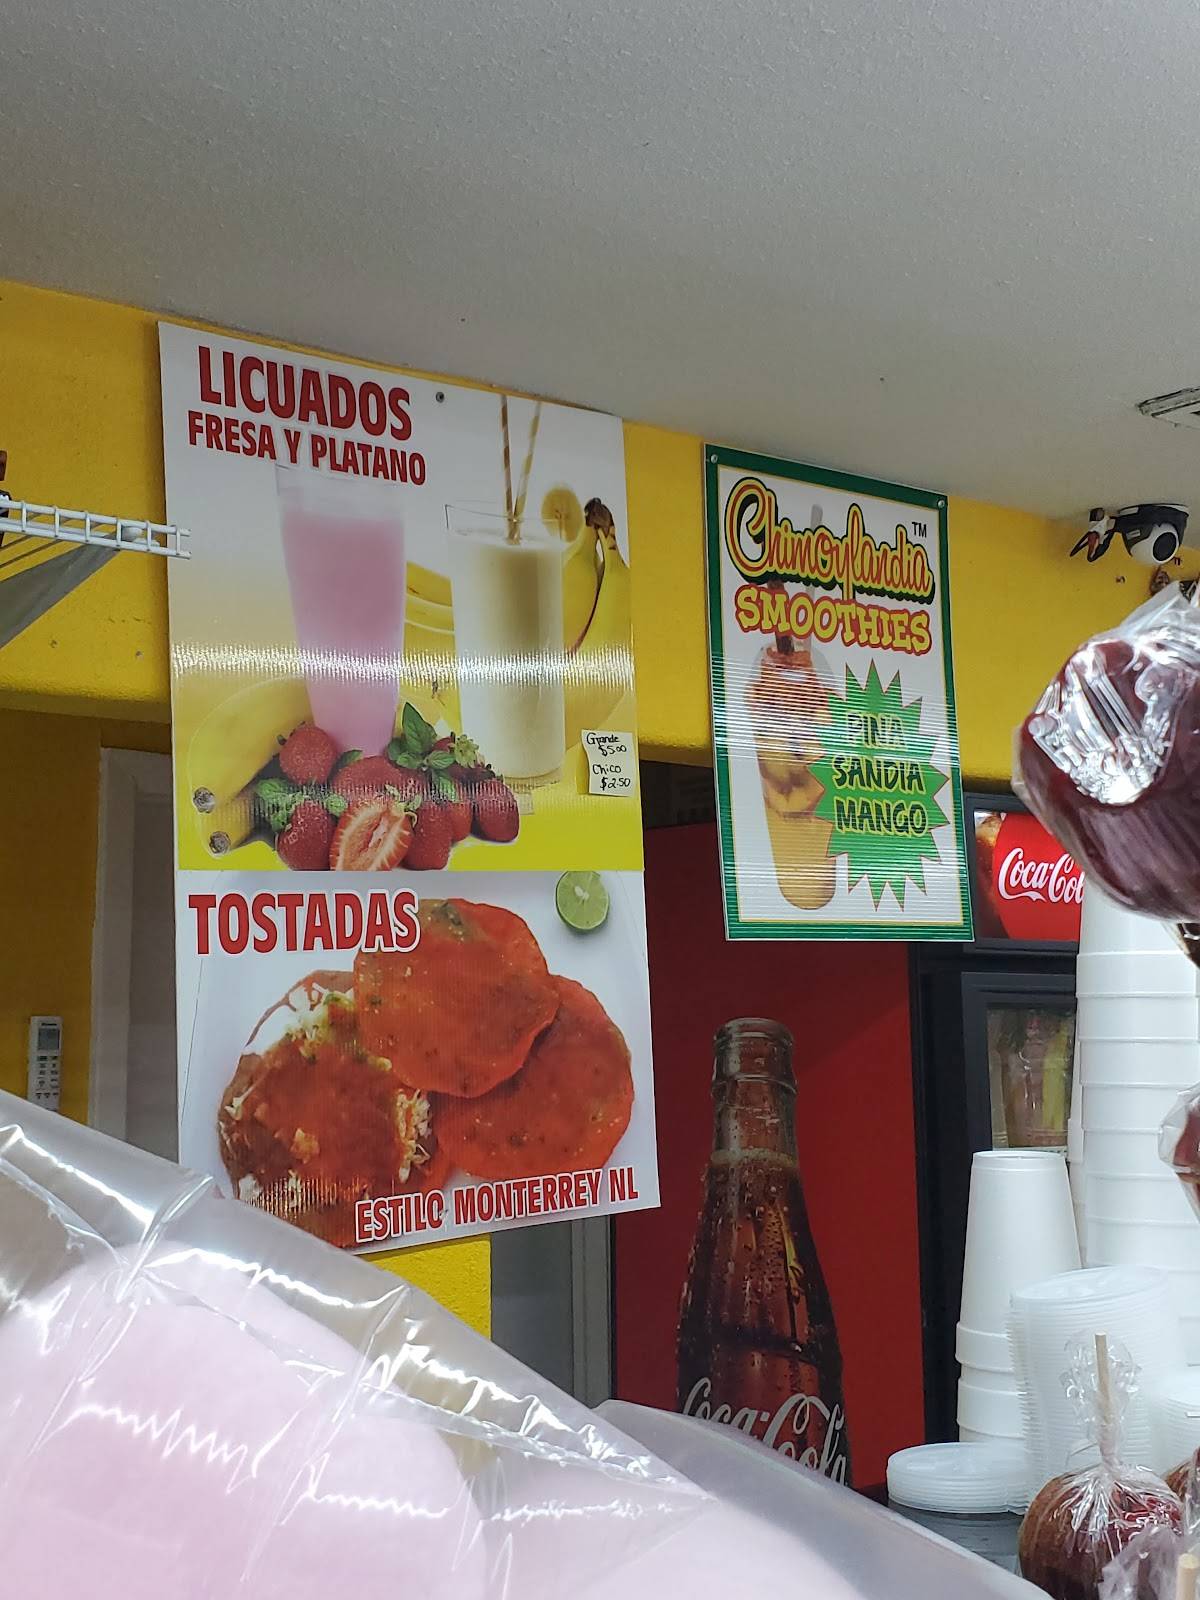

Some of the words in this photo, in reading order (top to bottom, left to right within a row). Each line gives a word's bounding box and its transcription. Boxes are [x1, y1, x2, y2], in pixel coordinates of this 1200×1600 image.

[198, 345, 412, 441] LICUADOS
[188, 409, 277, 460] FRESA
[283, 428, 301, 464] Y
[310, 433, 426, 486] PLATANO
[725, 477, 935, 604] Chimoylandia
[912, 522, 927, 538] TM
[735, 584, 932, 656] SMOOTHIES
[586, 732, 620, 746] Grande
[592, 763, 622, 775] Chico
[600, 776, 631, 791] $2.50
[832, 756, 926, 793] SANDIA
[834, 797, 929, 836] MANGO
[188, 891, 418, 954] TOSTADAS
[356, 1192, 444, 1242] ESTILO
[454, 1170, 602, 1225] MONTERREY
[609, 1166, 639, 1201] NL
